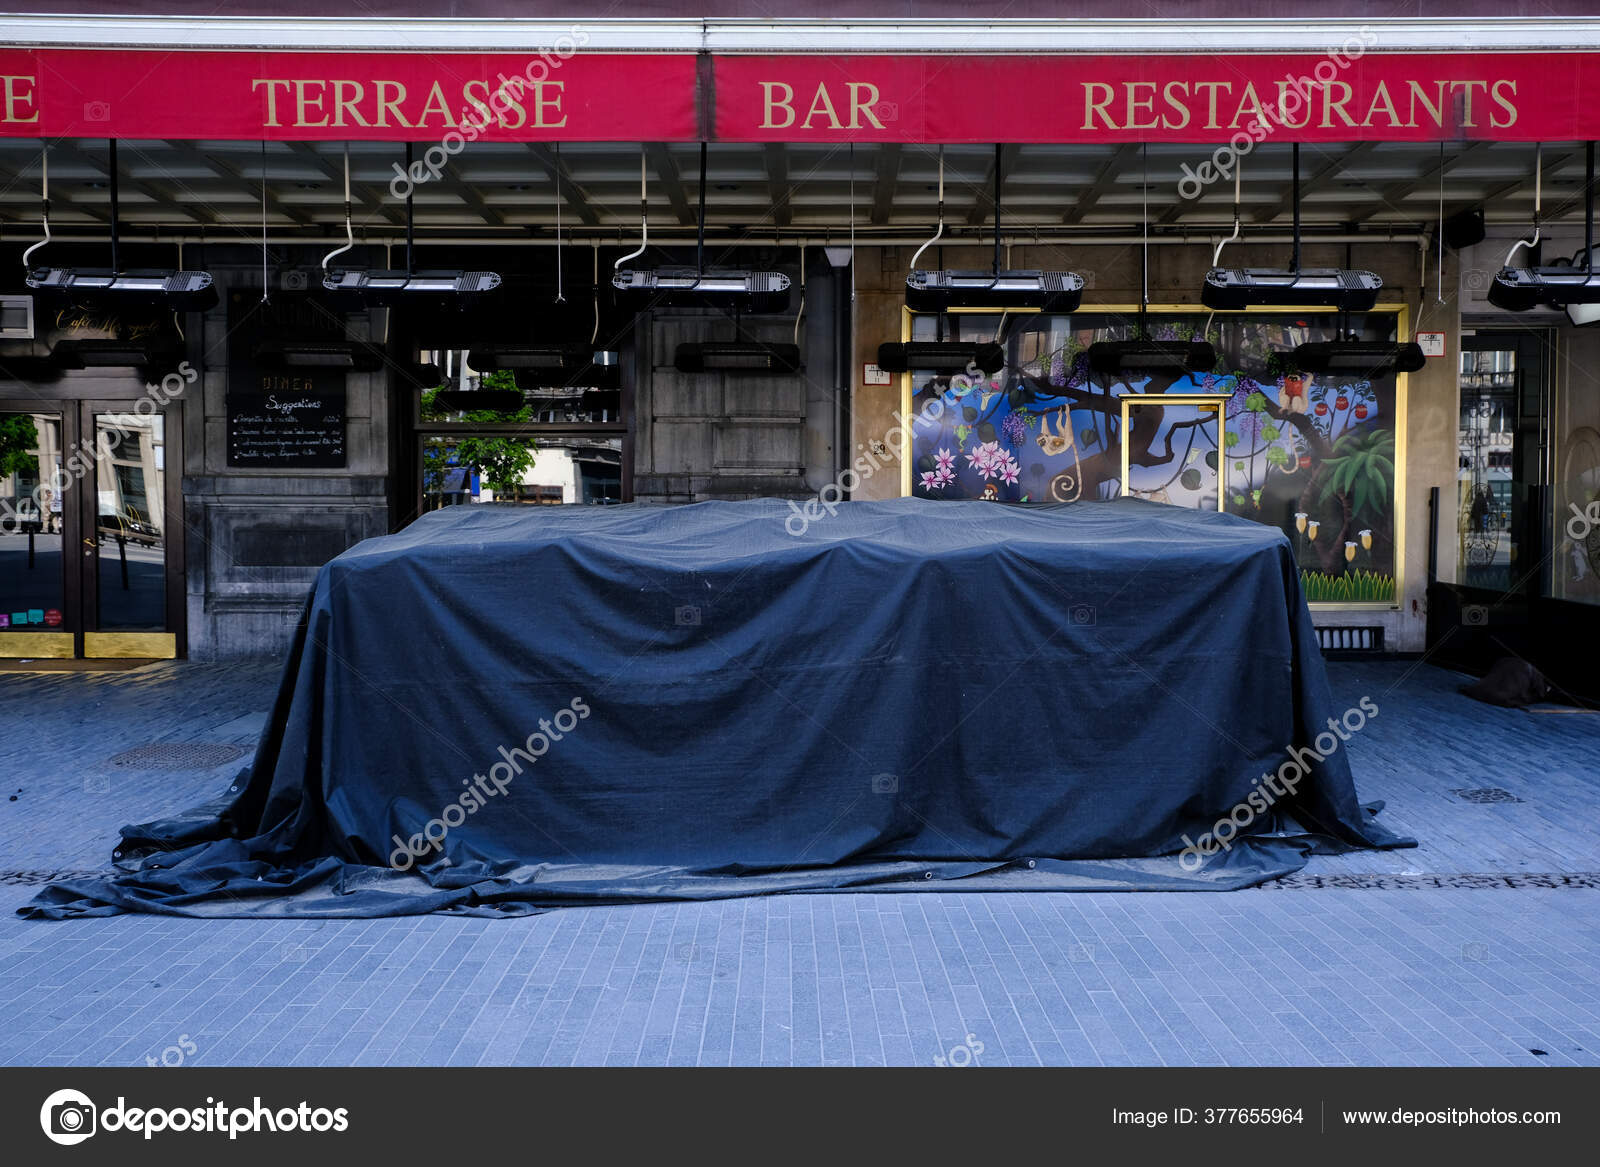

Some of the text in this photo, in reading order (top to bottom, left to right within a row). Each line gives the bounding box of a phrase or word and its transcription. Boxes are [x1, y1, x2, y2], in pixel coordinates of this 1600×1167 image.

[1, 76, 39, 123] E
[252, 79, 568, 129] TERRASSE
[758, 81, 886, 129] BAR
[1080, 79, 1518, 130] RESTAURANTS
[265, 394, 322, 414] Suggestions
